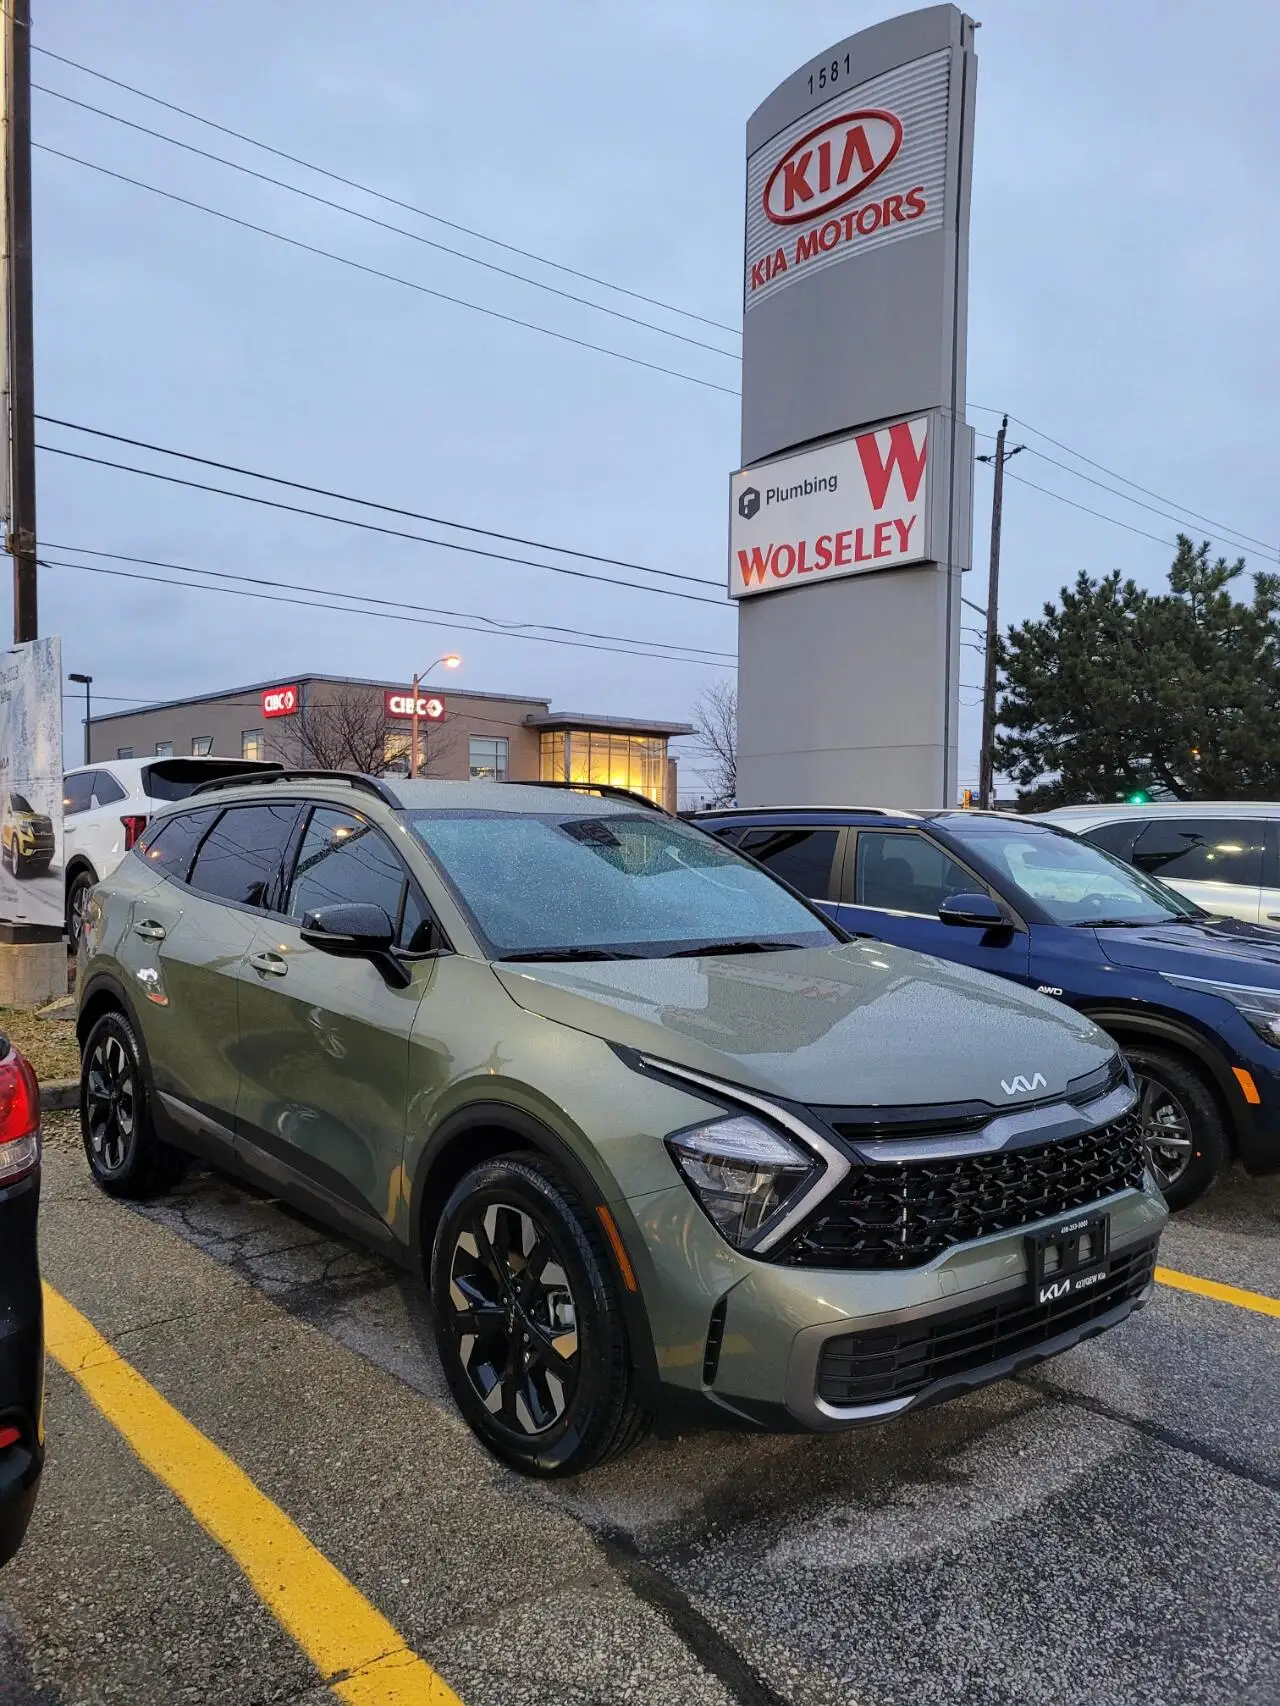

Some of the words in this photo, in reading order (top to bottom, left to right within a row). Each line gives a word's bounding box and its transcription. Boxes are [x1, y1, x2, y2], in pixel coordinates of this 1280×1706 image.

[807, 53, 851, 95] 1581
[783, 125, 876, 212] KIA
[750, 247, 789, 291] KIA
[795, 185, 927, 265] MOTORS
[854, 422, 928, 510] W
[766, 474, 839, 505] Plumbing
[737, 514, 918, 587] WOLSELEY
[264, 693, 286, 712] CIBC
[389, 696, 427, 716] CIBC
[1037, 985, 1064, 996] AWD
[1000, 1072, 1047, 1096] KIA
[1039, 1278, 1070, 1303] KIA
